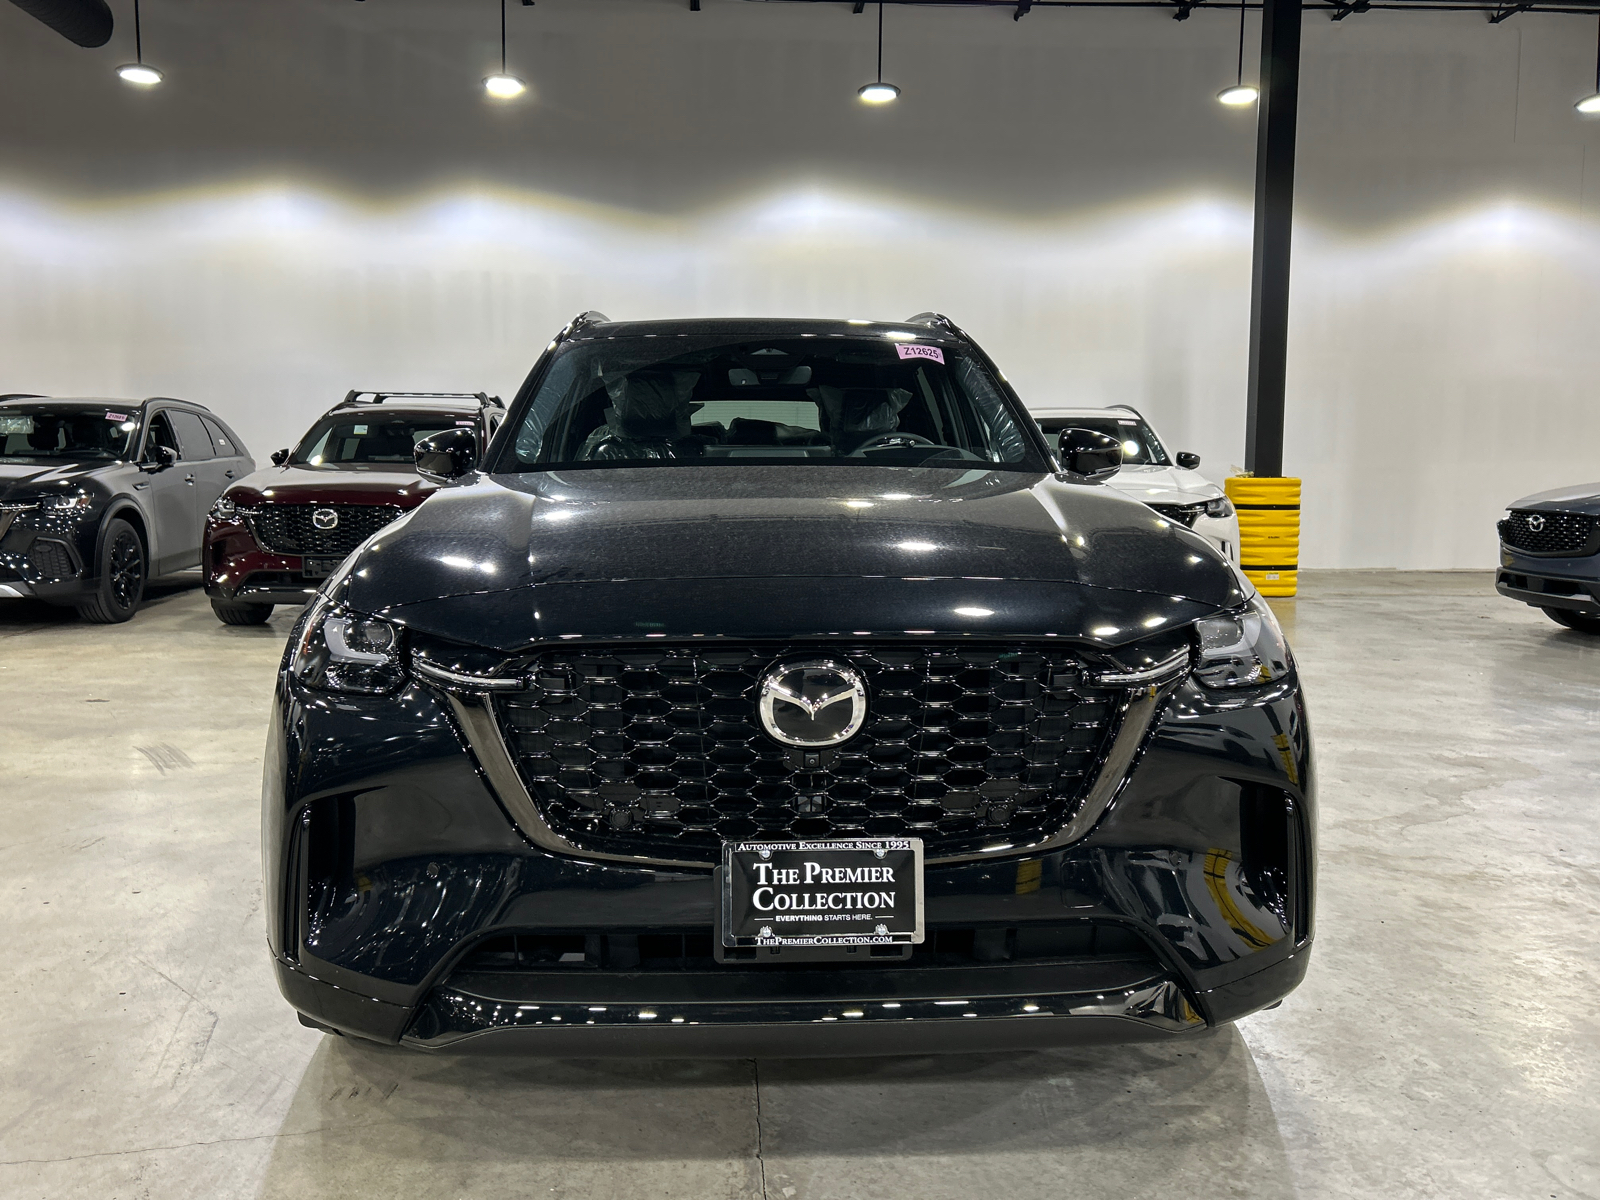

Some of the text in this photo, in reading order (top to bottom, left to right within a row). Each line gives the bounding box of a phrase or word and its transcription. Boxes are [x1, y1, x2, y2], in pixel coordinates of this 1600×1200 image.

[904, 347, 939, 359] Z12625
[738, 840, 909, 851] AUTOMOTIVE EXCELLENCE SINCE 1995
[753, 862, 896, 885] THE PREMIER
[752, 886, 896, 911] COLLECTION
[775, 914, 823, 922] EVERYTHING
[851, 913, 873, 921] HERE.
